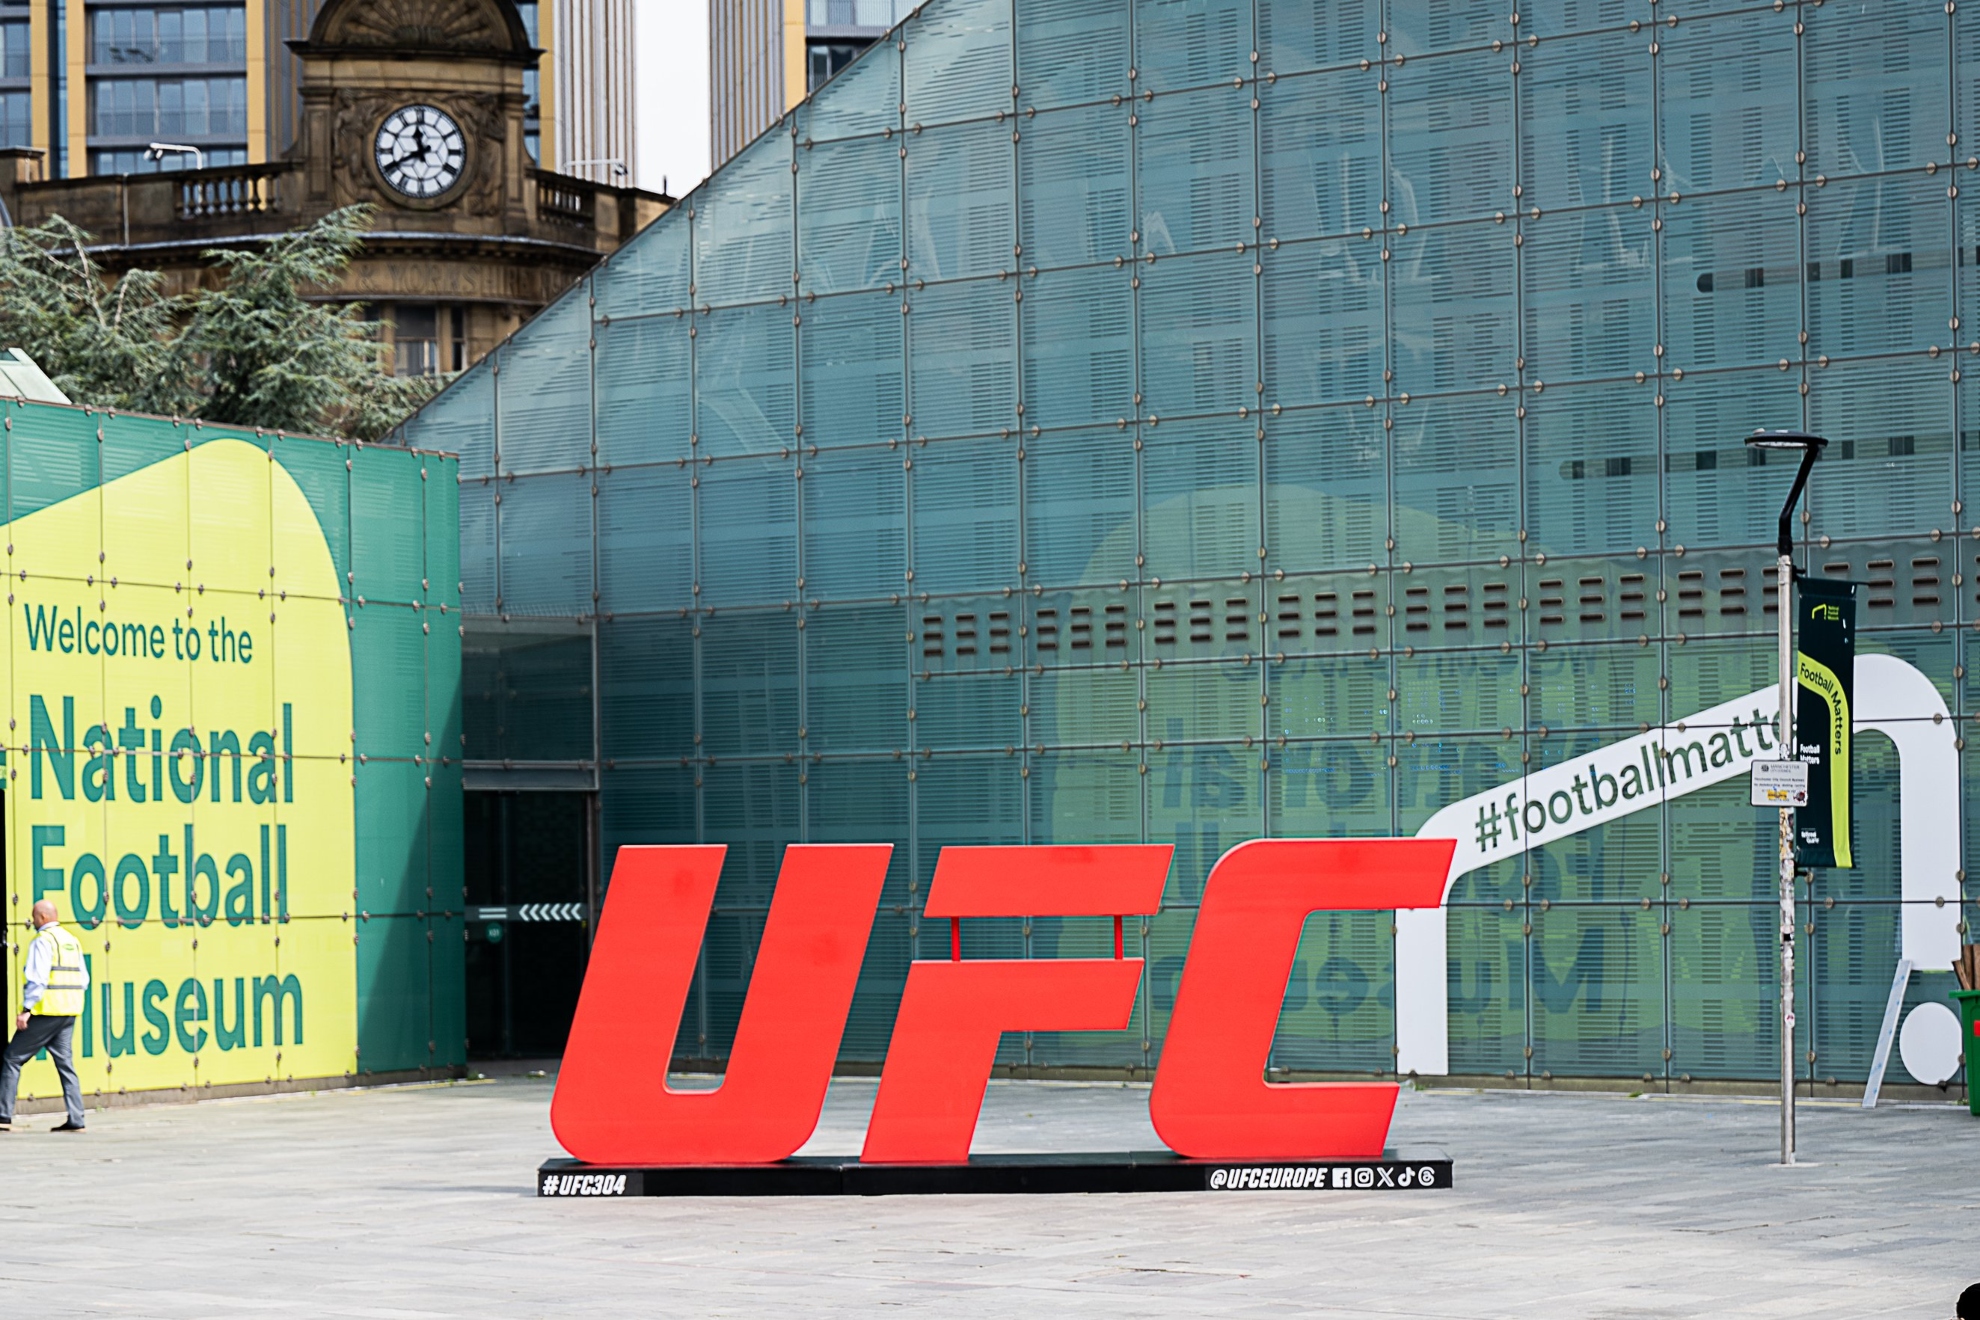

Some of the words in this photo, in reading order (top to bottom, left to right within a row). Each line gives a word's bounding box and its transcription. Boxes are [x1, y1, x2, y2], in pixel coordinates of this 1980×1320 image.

[24, 603, 165, 658] Welcome
[172, 617, 201, 661] to
[208, 616, 253, 664] the
[30, 694, 294, 805] National
[1800, 663, 1833, 694] Football
[1831, 690, 1843, 756] Matters
[32, 823, 288, 930] Football
[550, 837, 1457, 1164] UFC
[543, 1174, 627, 1196] #UFC304
[1210, 1167, 1328, 1190] @UFCEUROPE
